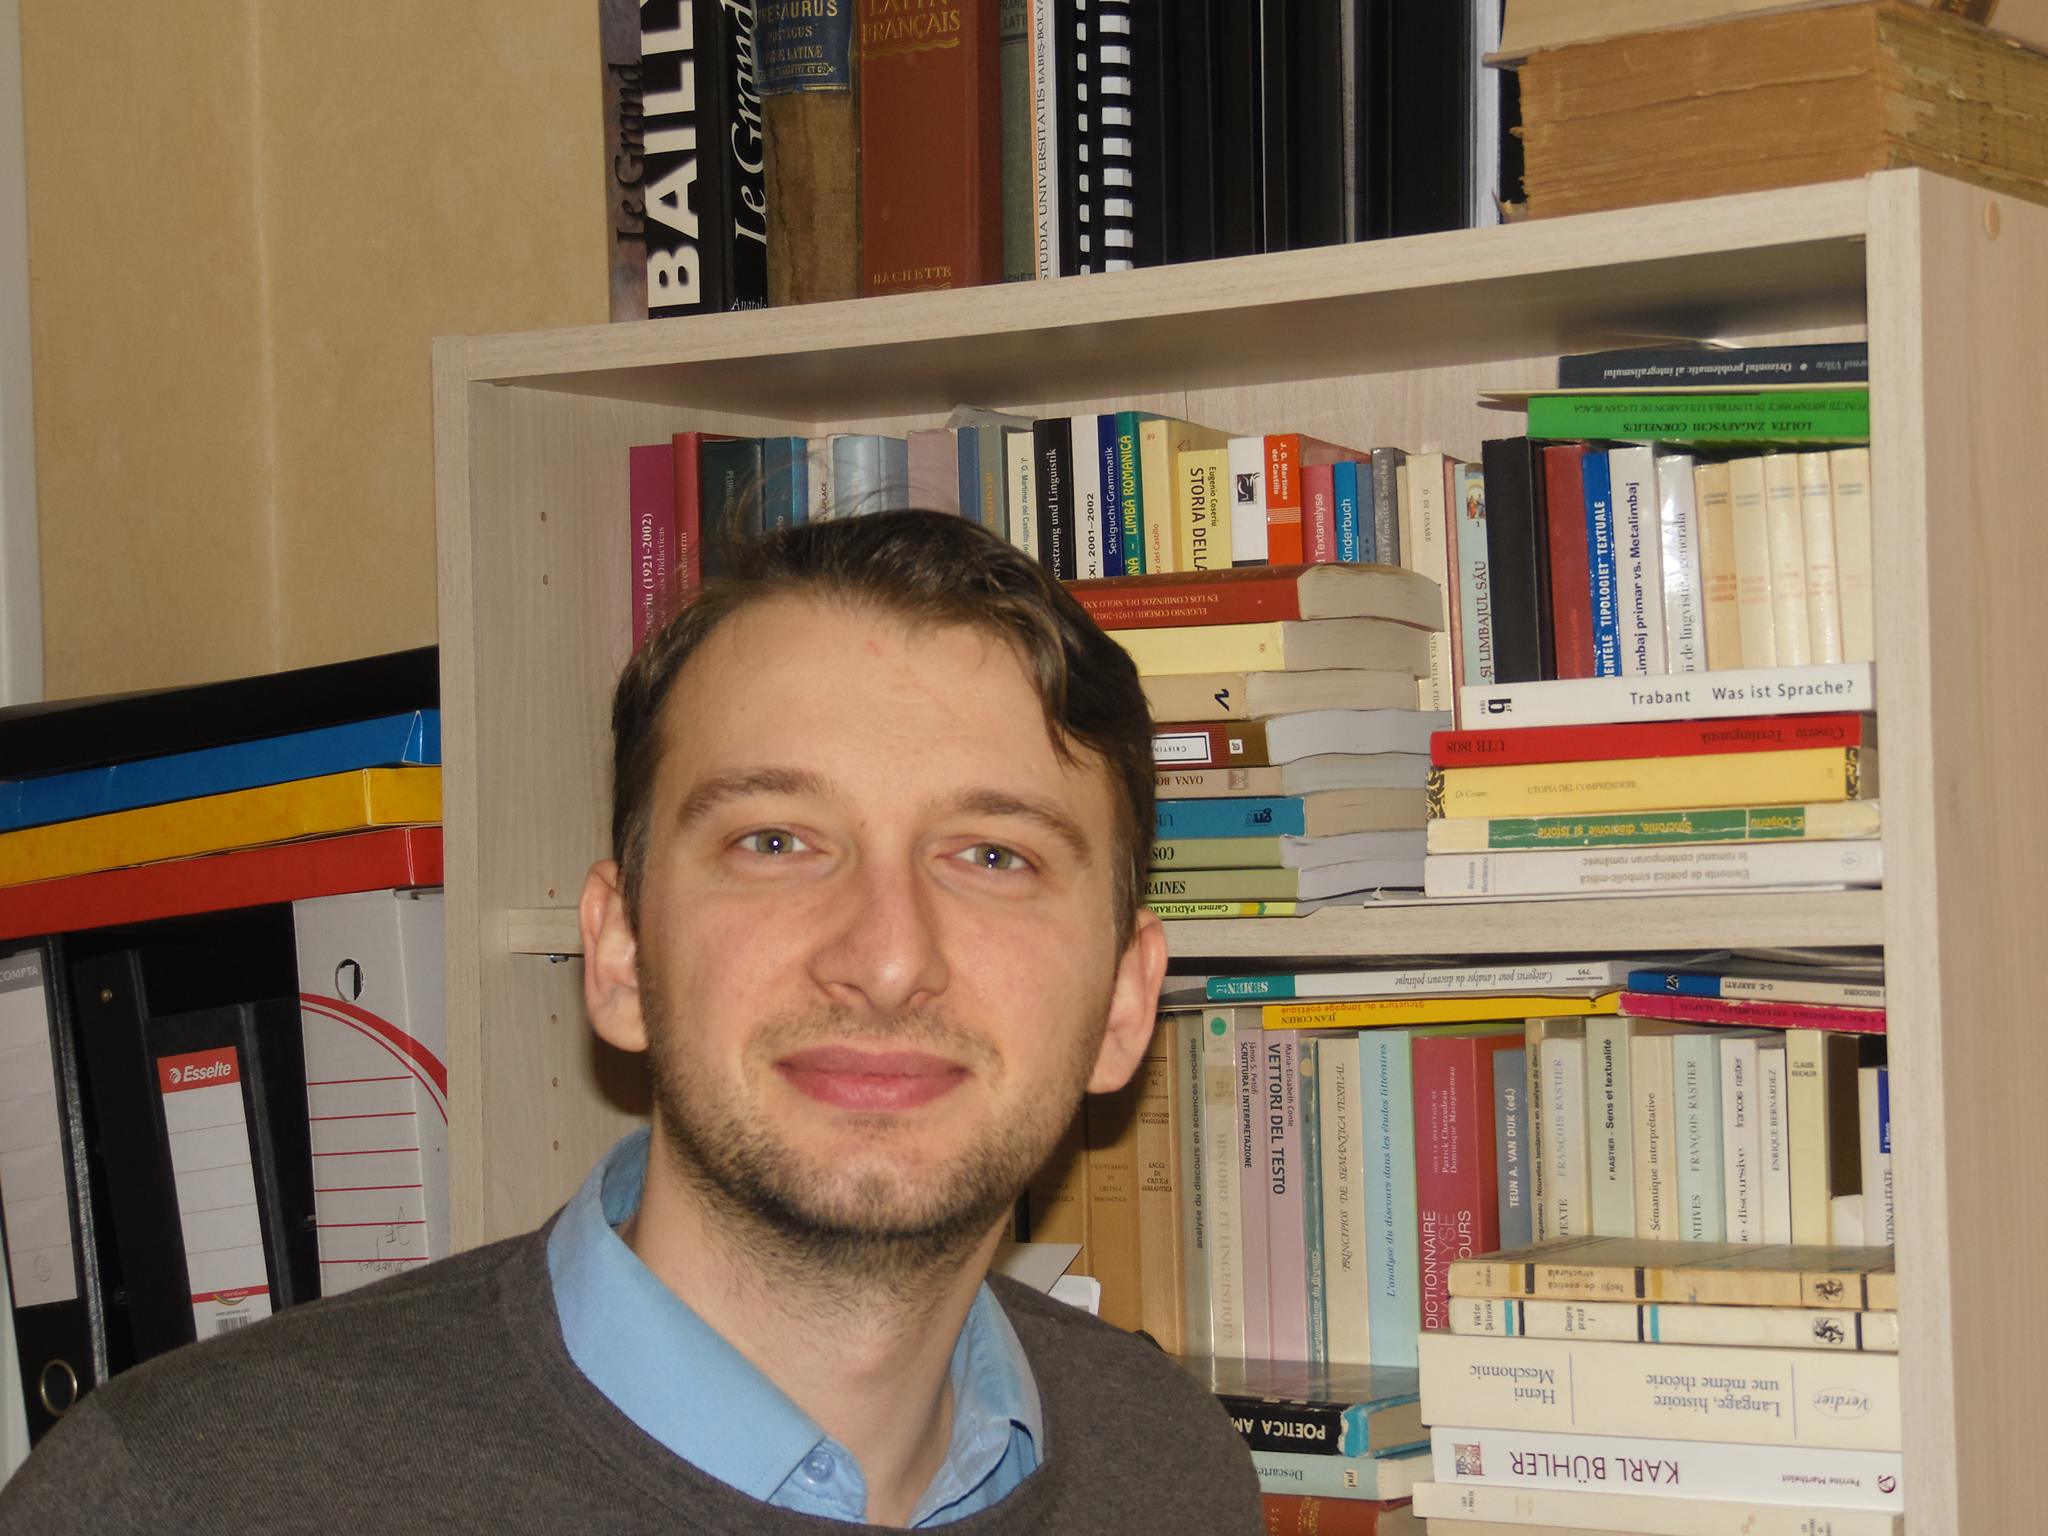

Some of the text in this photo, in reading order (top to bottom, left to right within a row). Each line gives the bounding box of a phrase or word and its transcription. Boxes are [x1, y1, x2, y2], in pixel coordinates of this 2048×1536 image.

[608, 60, 646, 245] Le Grand
[641, 0, 700, 308] BAILL
[1034, 87, 1049, 215] UNIVERSITATIS
[733, 186, 767, 246] Le
[1046, 448, 1061, 526] und Linguistik
[1104, 447, 1118, 555] Sekiguchi-Grammatik
[1190, 467, 1206, 524] STORIA
[1207, 466, 1219, 527] Eugenio Coseriu
[1312, 493, 1327, 557] Textanalyse
[1593, 501, 1609, 555] TEXTUALE
[641, 512, 655, 589] (1921-2002)
[1626, 482, 1648, 629] primar vs. Metalimbaj
[1472, 560, 1492, 661] LIMBAJUL SĂU
[1681, 643, 1694, 660] de
[1629, 679, 1854, 706] Trabant Was ist Sprache?
[1176, 774, 1204, 786] OANA
[1690, 870, 1703, 881] de
[1197, 904, 1228, 914] Carmen
[1280, 1012, 1337, 1025] JEAN COHEN
[183, 1061, 233, 1082] Esselte
[1239, 1042, 1250, 1086] SCRITTURA
[1601, 1039, 1614, 1088] textualité
[1604, 1090, 1615, 1101] et
[1267, 1042, 1286, 1195] VETTORI DEL TESTO
[1604, 1101, 1616, 1130] Sens
[1686, 1059, 1702, 1173] FRANÇOIS RASTIER
[1187, 1038, 1206, 1250] analyse du discours en sciences sociales
[1242, 1094, 1253, 1169] INTERPRETAZIONE
[1380, 1136, 1391, 1151] les
[1506, 1139, 1518, 1163] VAN
[1645, 1092, 1663, 1231] Sémantique interprétative
[1381, 1154, 1392, 1180] dans
[1507, 1166, 1519, 1178] A.
[1382, 1182, 1394, 1228] discours
[1508, 1180, 1520, 1208] TEUN
[1383, 1230, 1394, 1245] du
[1421, 1210, 1439, 1330] DICTIONNAIRE
[1470, 1362, 1557, 1384] Meschonnic
[1646, 1373, 1783, 1394] une même théorie
[1514, 1386, 1557, 1405] Henri
[1654, 1394, 1783, 1418] Langage, histoire
[1814, 1391, 1871, 1411] Verdier
[1260, 1419, 1327, 1440] POETICA
[1508, 1450, 1609, 1481] BÜHLER
[1615, 1455, 1681, 1485] KARL
